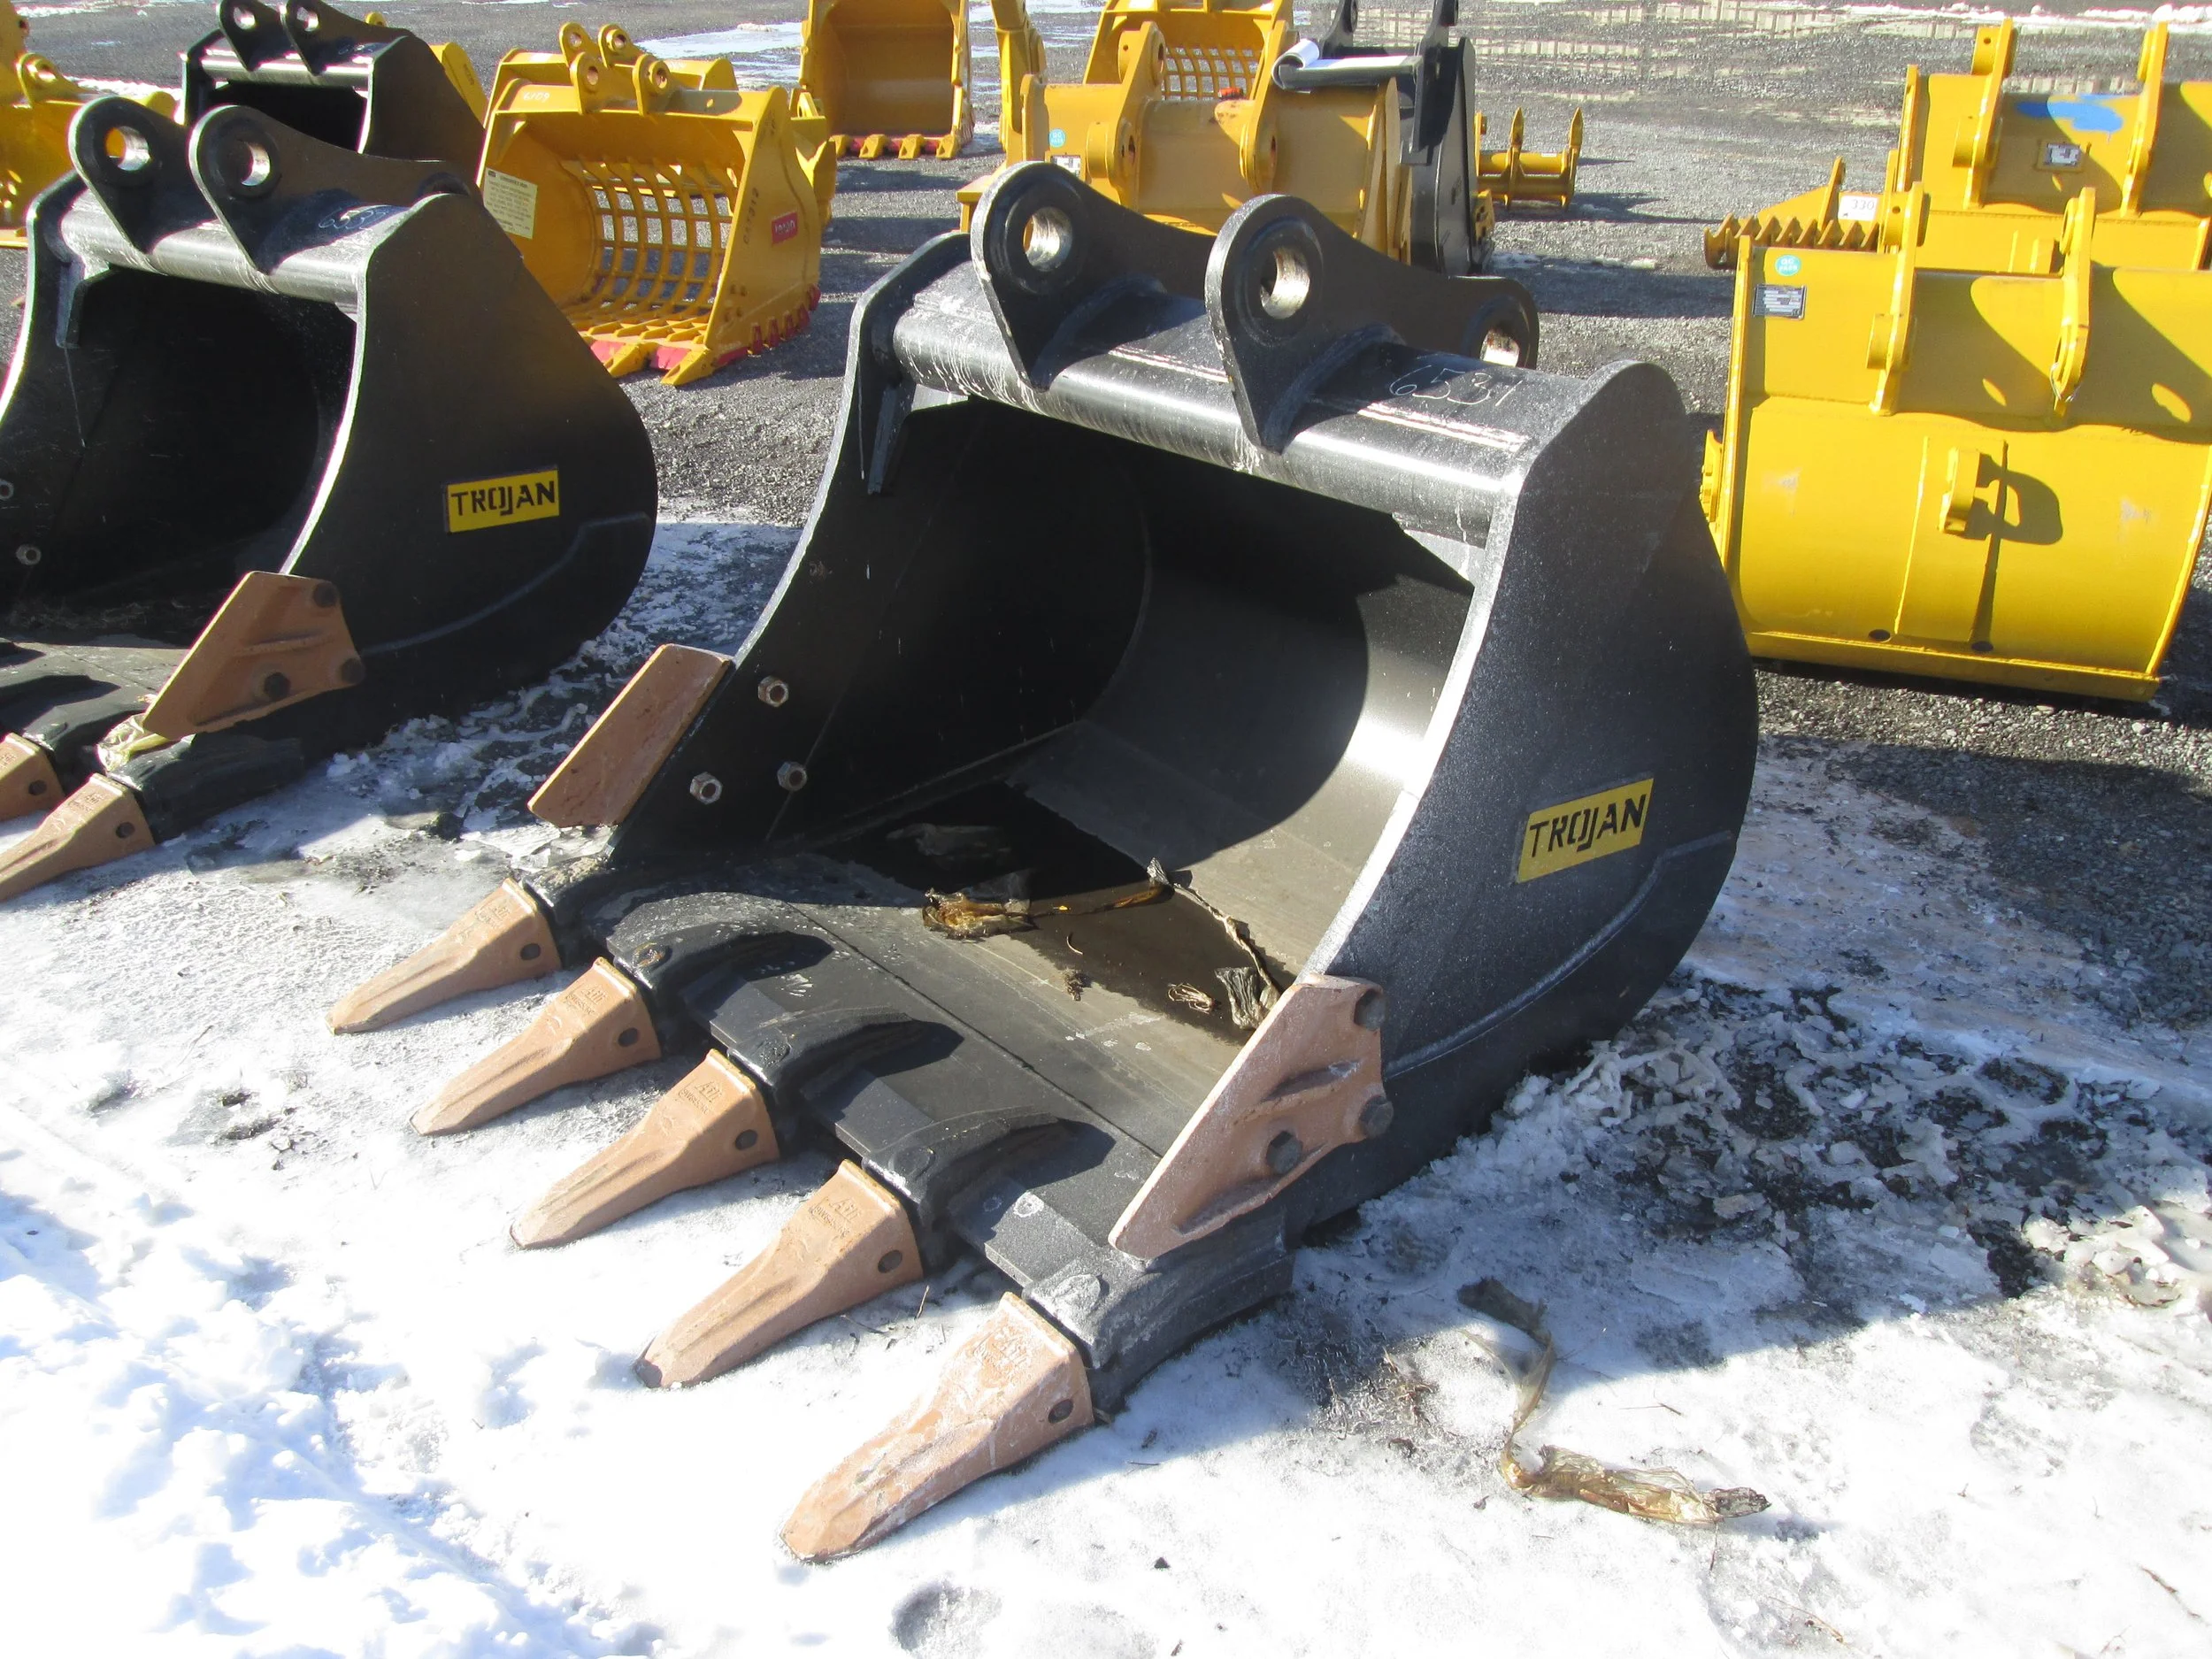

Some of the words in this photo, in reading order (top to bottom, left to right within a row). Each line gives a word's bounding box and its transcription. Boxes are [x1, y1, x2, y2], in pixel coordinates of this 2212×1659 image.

[1850, 197, 1875, 211] 330
[451, 480, 555, 516] TROJAN
[1529, 794, 1647, 858] TROJAN
